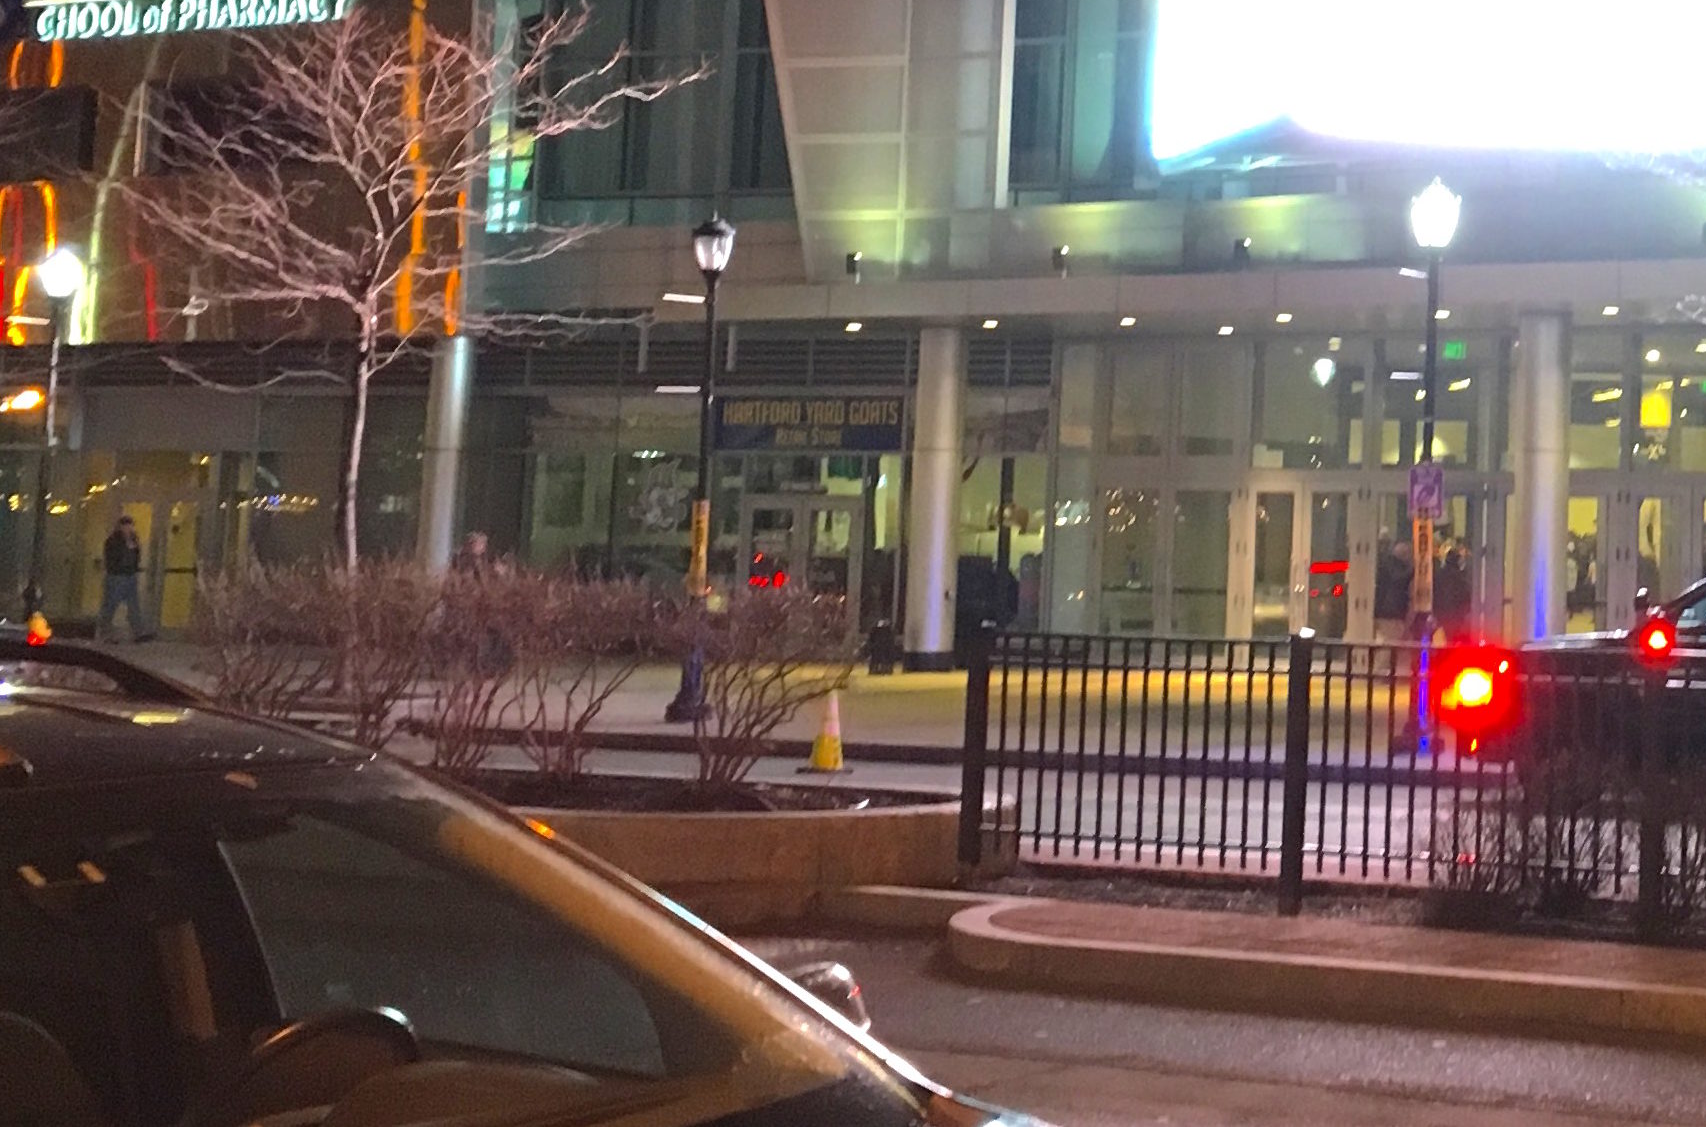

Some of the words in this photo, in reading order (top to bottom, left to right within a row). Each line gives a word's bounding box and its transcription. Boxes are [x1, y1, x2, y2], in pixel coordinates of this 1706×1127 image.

[722, 400, 800, 425] HARTFORD
[806, 400, 845, 425] YARD
[849, 399, 899, 425] GOATS
